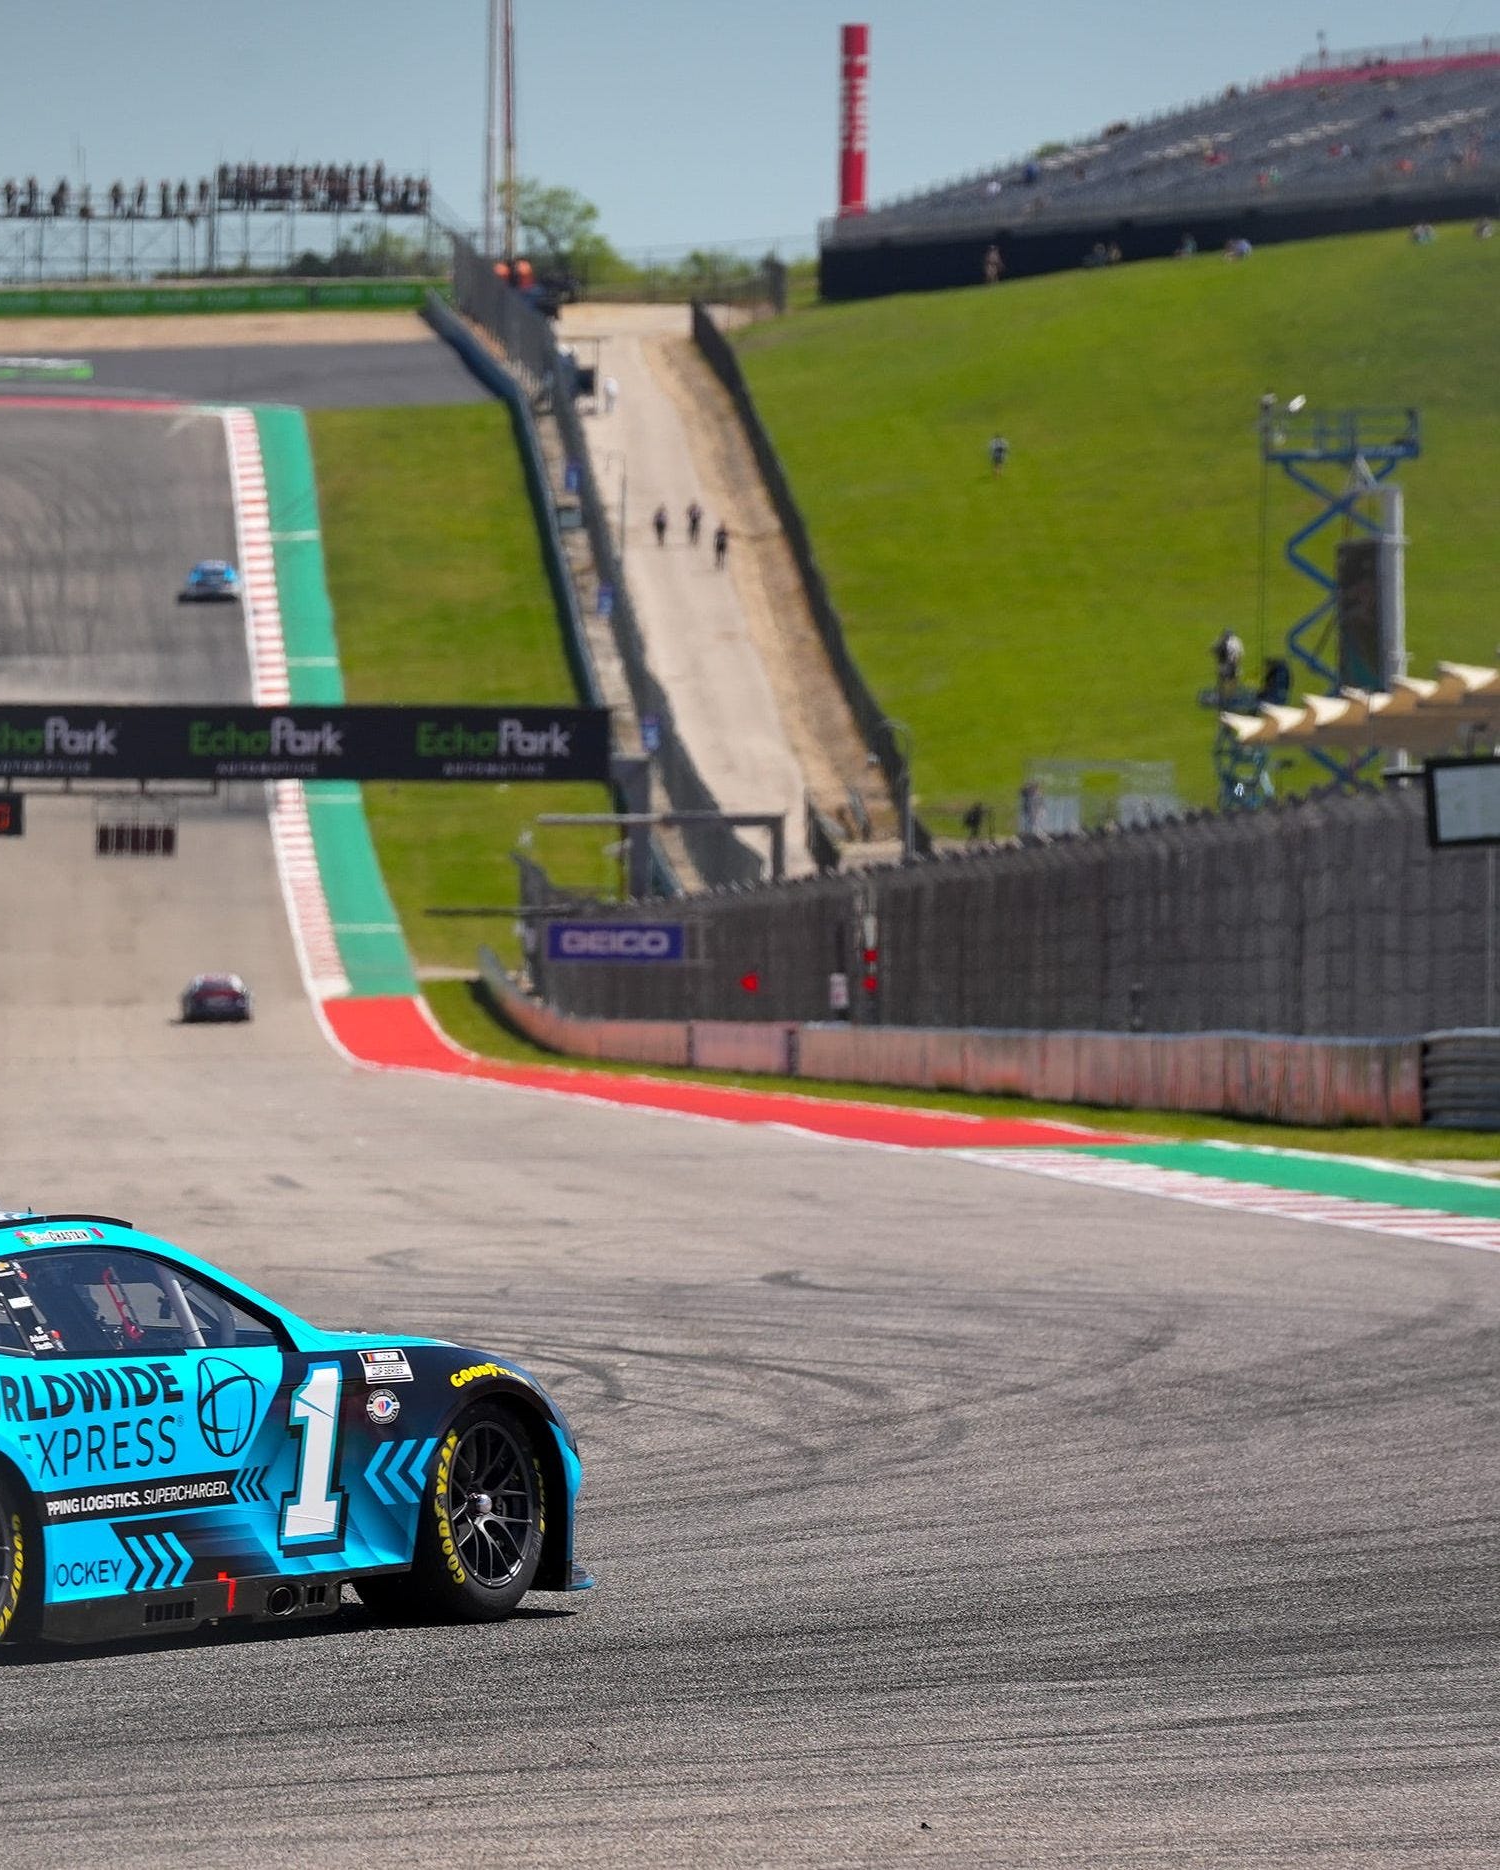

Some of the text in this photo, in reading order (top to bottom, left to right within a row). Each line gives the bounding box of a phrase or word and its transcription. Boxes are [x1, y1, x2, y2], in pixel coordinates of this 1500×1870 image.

[188, 716, 344, 757] EchoPark
[415, 717, 572, 758] EchoPark
[558, 929, 672, 955] GEICO
[280, 1362, 342, 1548] 1
[46, 1480, 230, 1516] PPING LOGISTICS. SUPERCHARGED.
